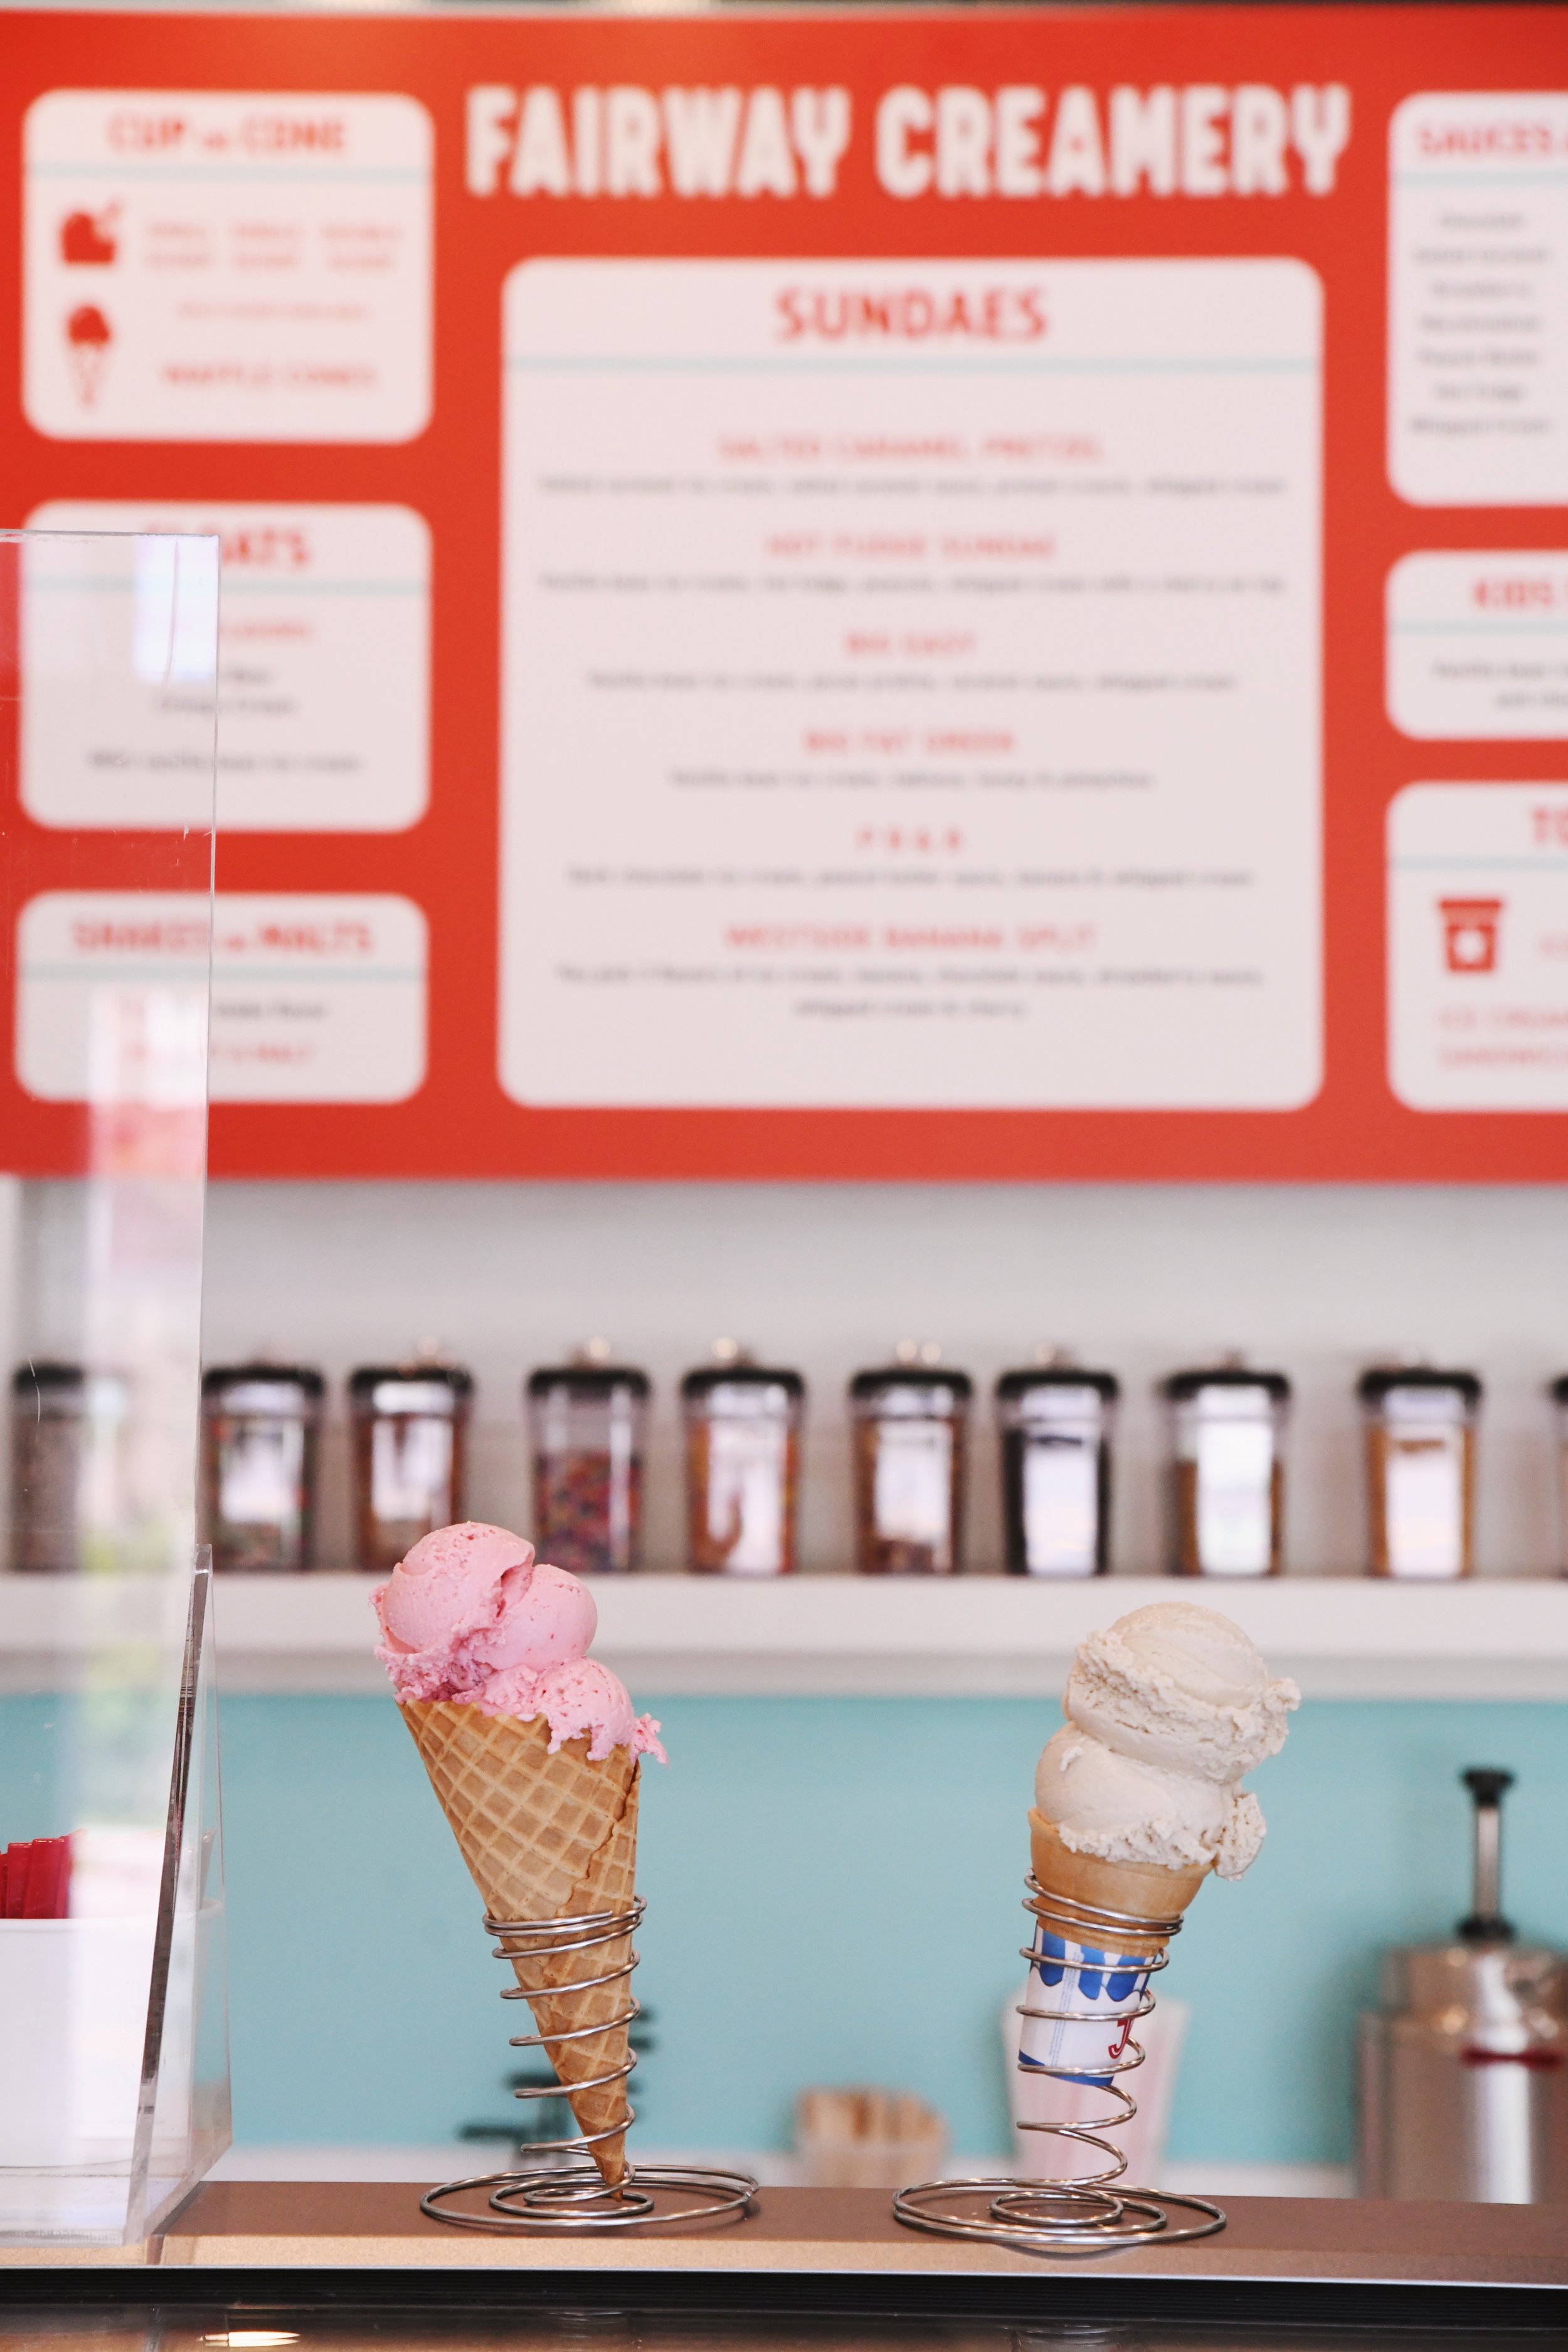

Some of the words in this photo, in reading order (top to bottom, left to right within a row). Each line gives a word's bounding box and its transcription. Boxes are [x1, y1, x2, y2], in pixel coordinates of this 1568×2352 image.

[107, 115, 191, 155] CUP
[240, 115, 350, 155] CONE
[467, 85, 850, 197] FAIRWAY
[878, 85, 1350, 197] CREAMERY
[1415, 123, 1555, 158] SAUCES
[775, 285, 1050, 341] SUNDAES
[1470, 576, 1557, 613] KIDS
[258, 918, 374, 954] MALTS
